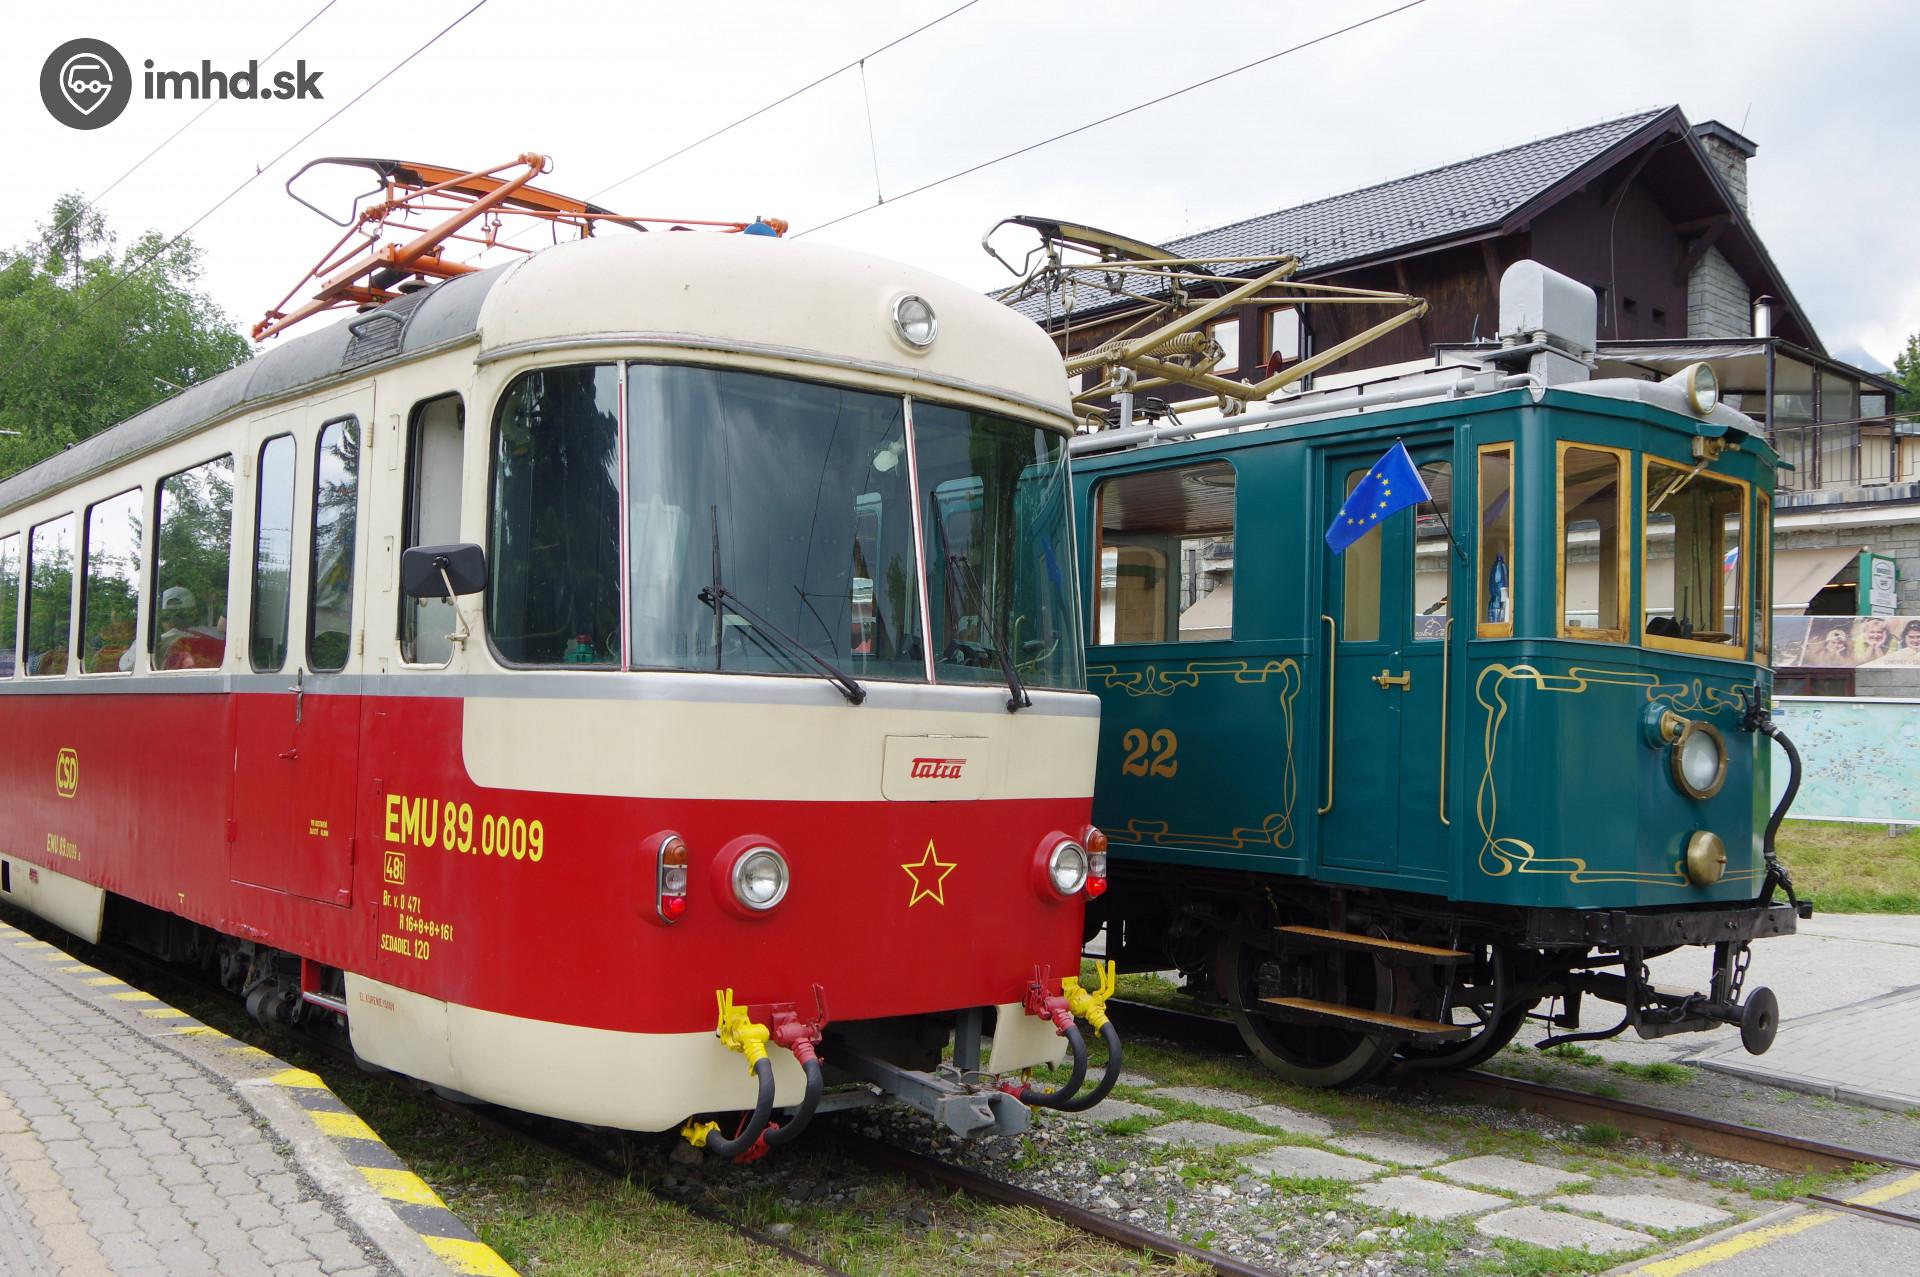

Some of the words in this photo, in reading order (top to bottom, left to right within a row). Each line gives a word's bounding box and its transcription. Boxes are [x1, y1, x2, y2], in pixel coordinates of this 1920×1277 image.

[1122, 728, 1178, 778] 22
[58, 752, 77, 789] ČSD
[911, 757, 967, 779] Tatra
[385, 794, 438, 847] EMU
[443, 801, 544, 862] 89.0009
[47, 832, 59, 855] EMU
[383, 889, 392, 907] Br.
[393, 895, 399, 908] v.
[381, 933, 411, 956] SEDADIEL
[414, 938, 430, 960] 120
